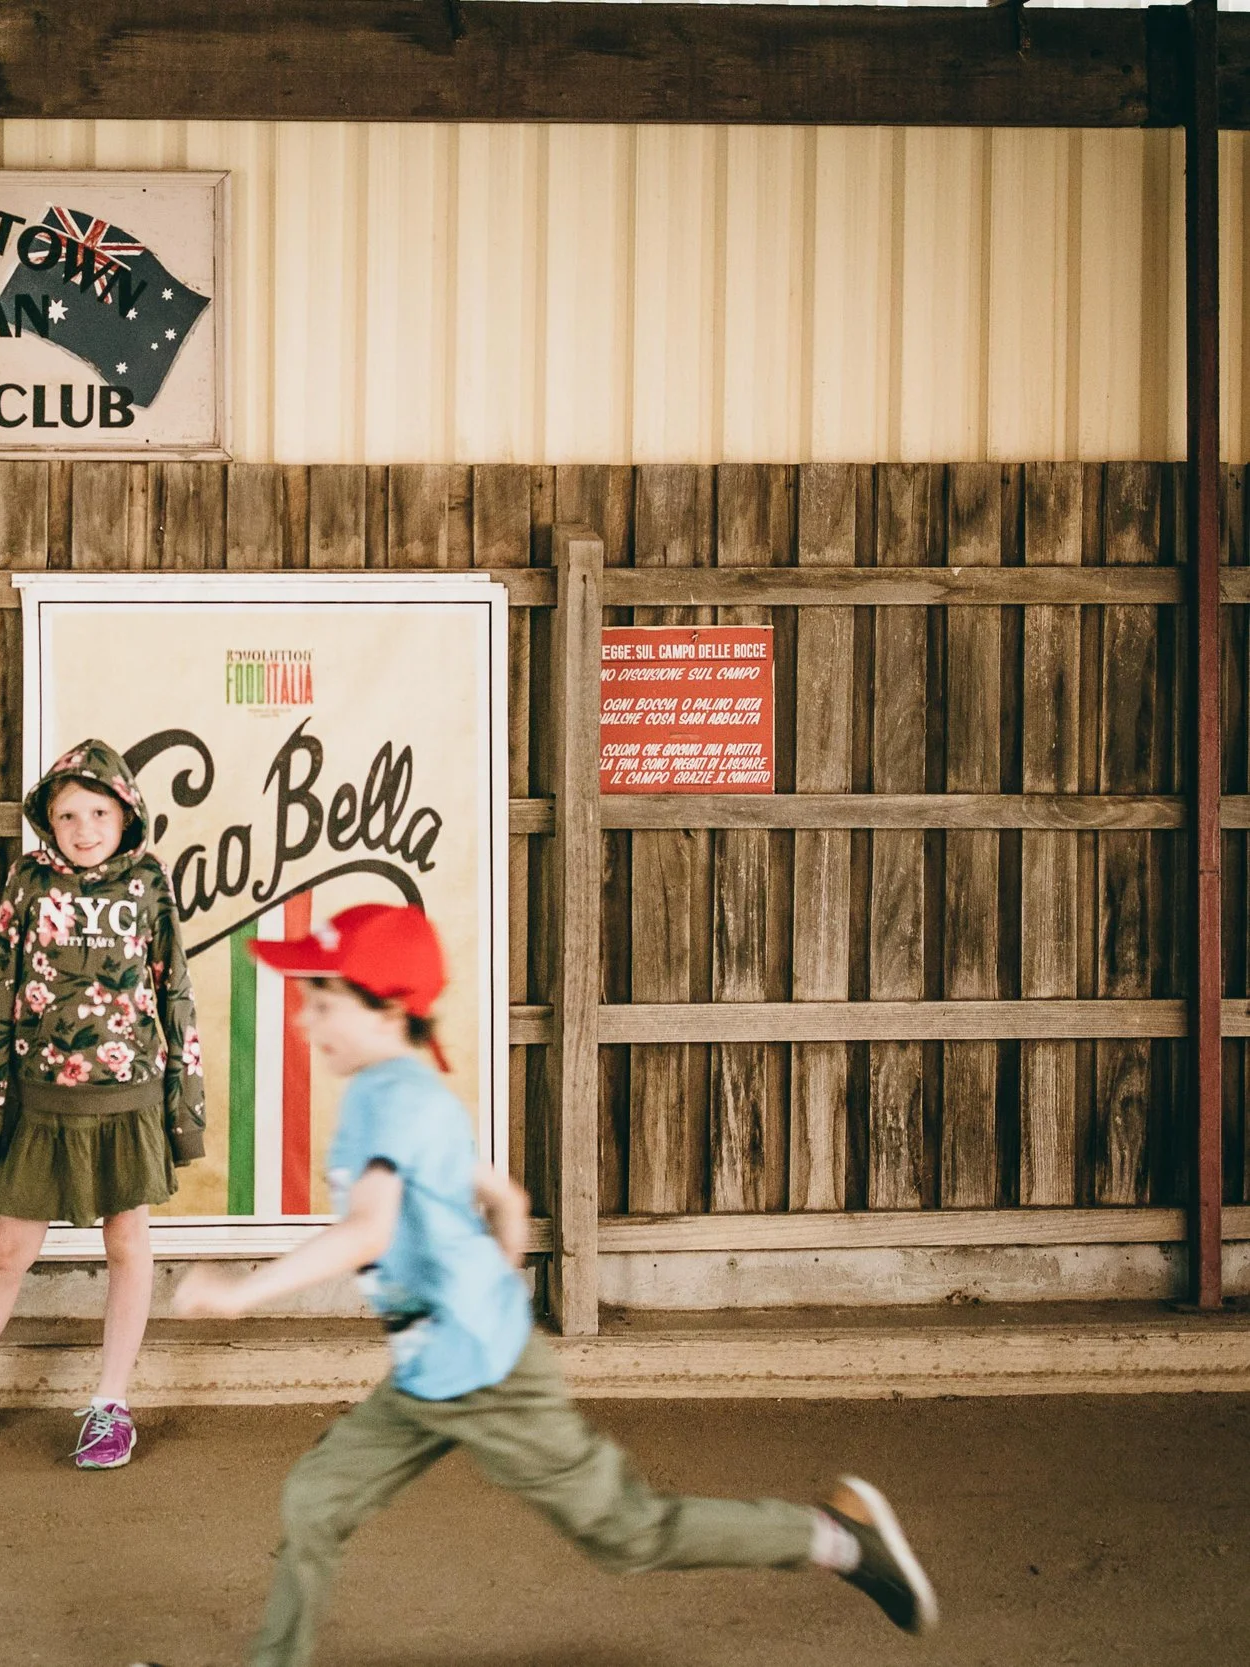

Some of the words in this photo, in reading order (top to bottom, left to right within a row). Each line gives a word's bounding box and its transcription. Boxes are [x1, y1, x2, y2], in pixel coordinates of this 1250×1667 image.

[636, 644, 656, 659] SUL
[659, 644, 695, 659] CAMPO
[699, 643, 730, 659] DELLE
[734, 643, 767, 658] BOCCE
[618, 667, 686, 681] DISCUSIONE
[687, 667, 713, 680] SUL
[716, 666, 761, 680] CAMPO
[603, 698, 635, 711] OGNI
[635, 698, 679, 711] BOCCIA
[681, 698, 692, 711] O
[734, 698, 763, 711] URTA
[600, 713, 645, 725] UALCHE
[645, 713, 676, 725] COSA
[707, 712, 761, 725] ABBOLITA
[642, 744, 663, 757] CHE
[702, 743, 724, 756] UNA
[723, 743, 763, 756] PARTITA
[641, 757, 669, 771] SONO
[669, 757, 709, 770] PREGATI
[707, 757, 719, 770] DI
[719, 757, 768, 770] LASCIARE
[610, 772, 626, 785] IL
[625, 772, 670, 785] CAMPO
[727, 771, 771, 784] COMITATO
[252, 716, 442, 902] Bella
[36, 896, 138, 937] NYC
